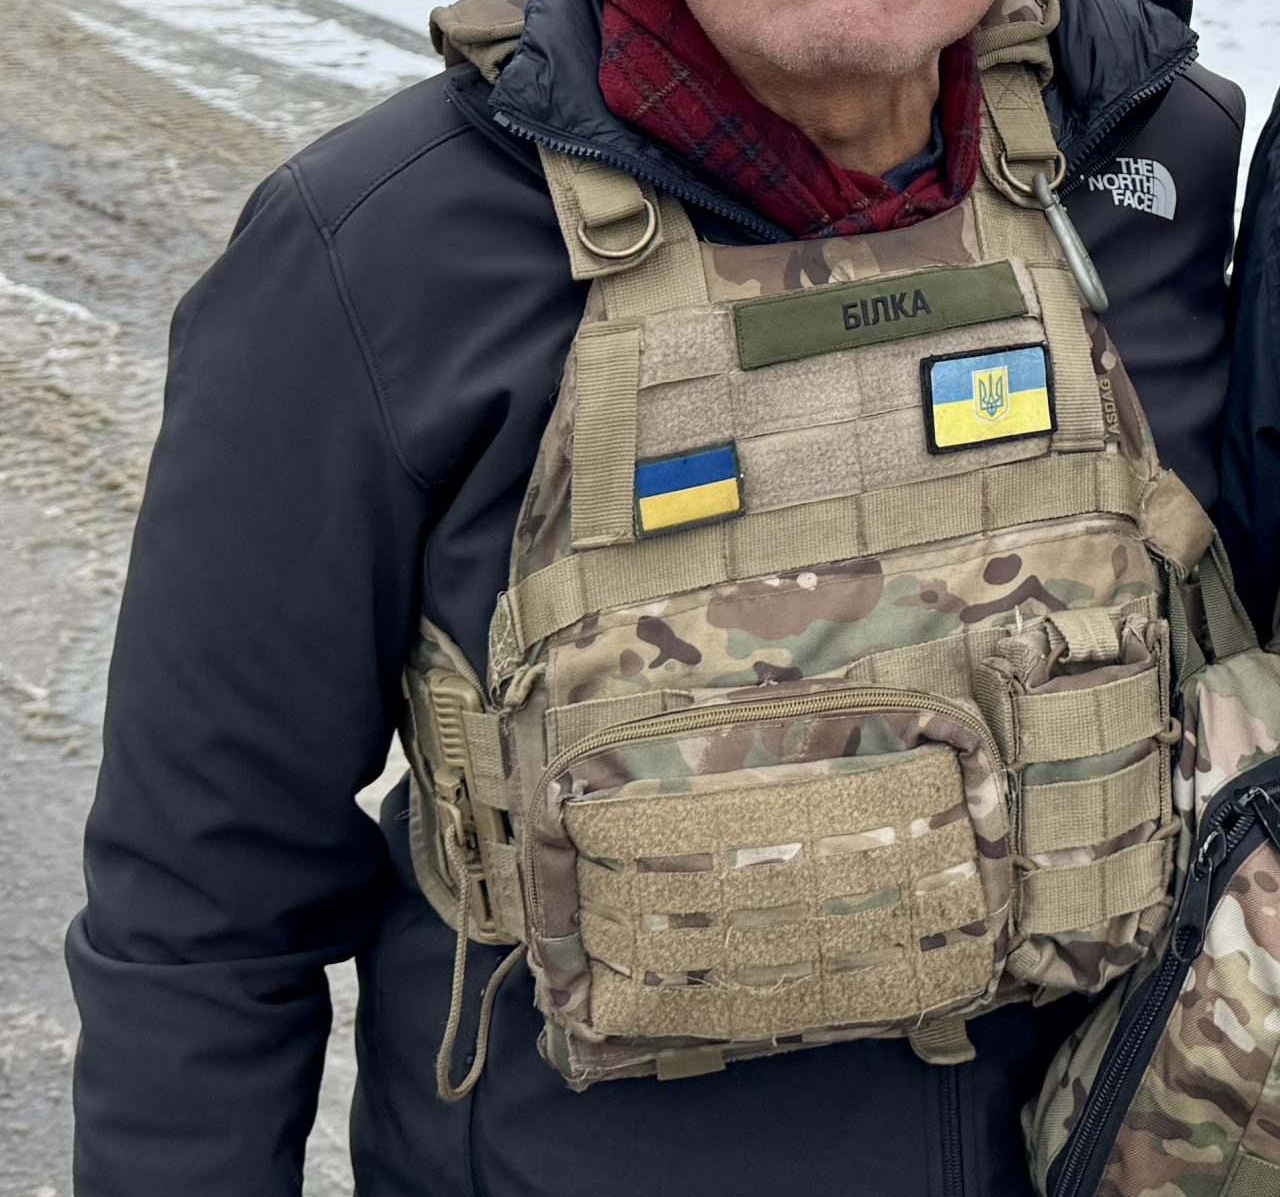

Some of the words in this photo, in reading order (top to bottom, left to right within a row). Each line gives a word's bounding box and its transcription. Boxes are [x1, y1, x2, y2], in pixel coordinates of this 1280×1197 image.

[1116, 157, 1153, 177] THE
[1087, 173, 1153, 194] NORTH
[1111, 189, 1153, 213] FACE
[842, 289, 932, 331] БІЛКА
